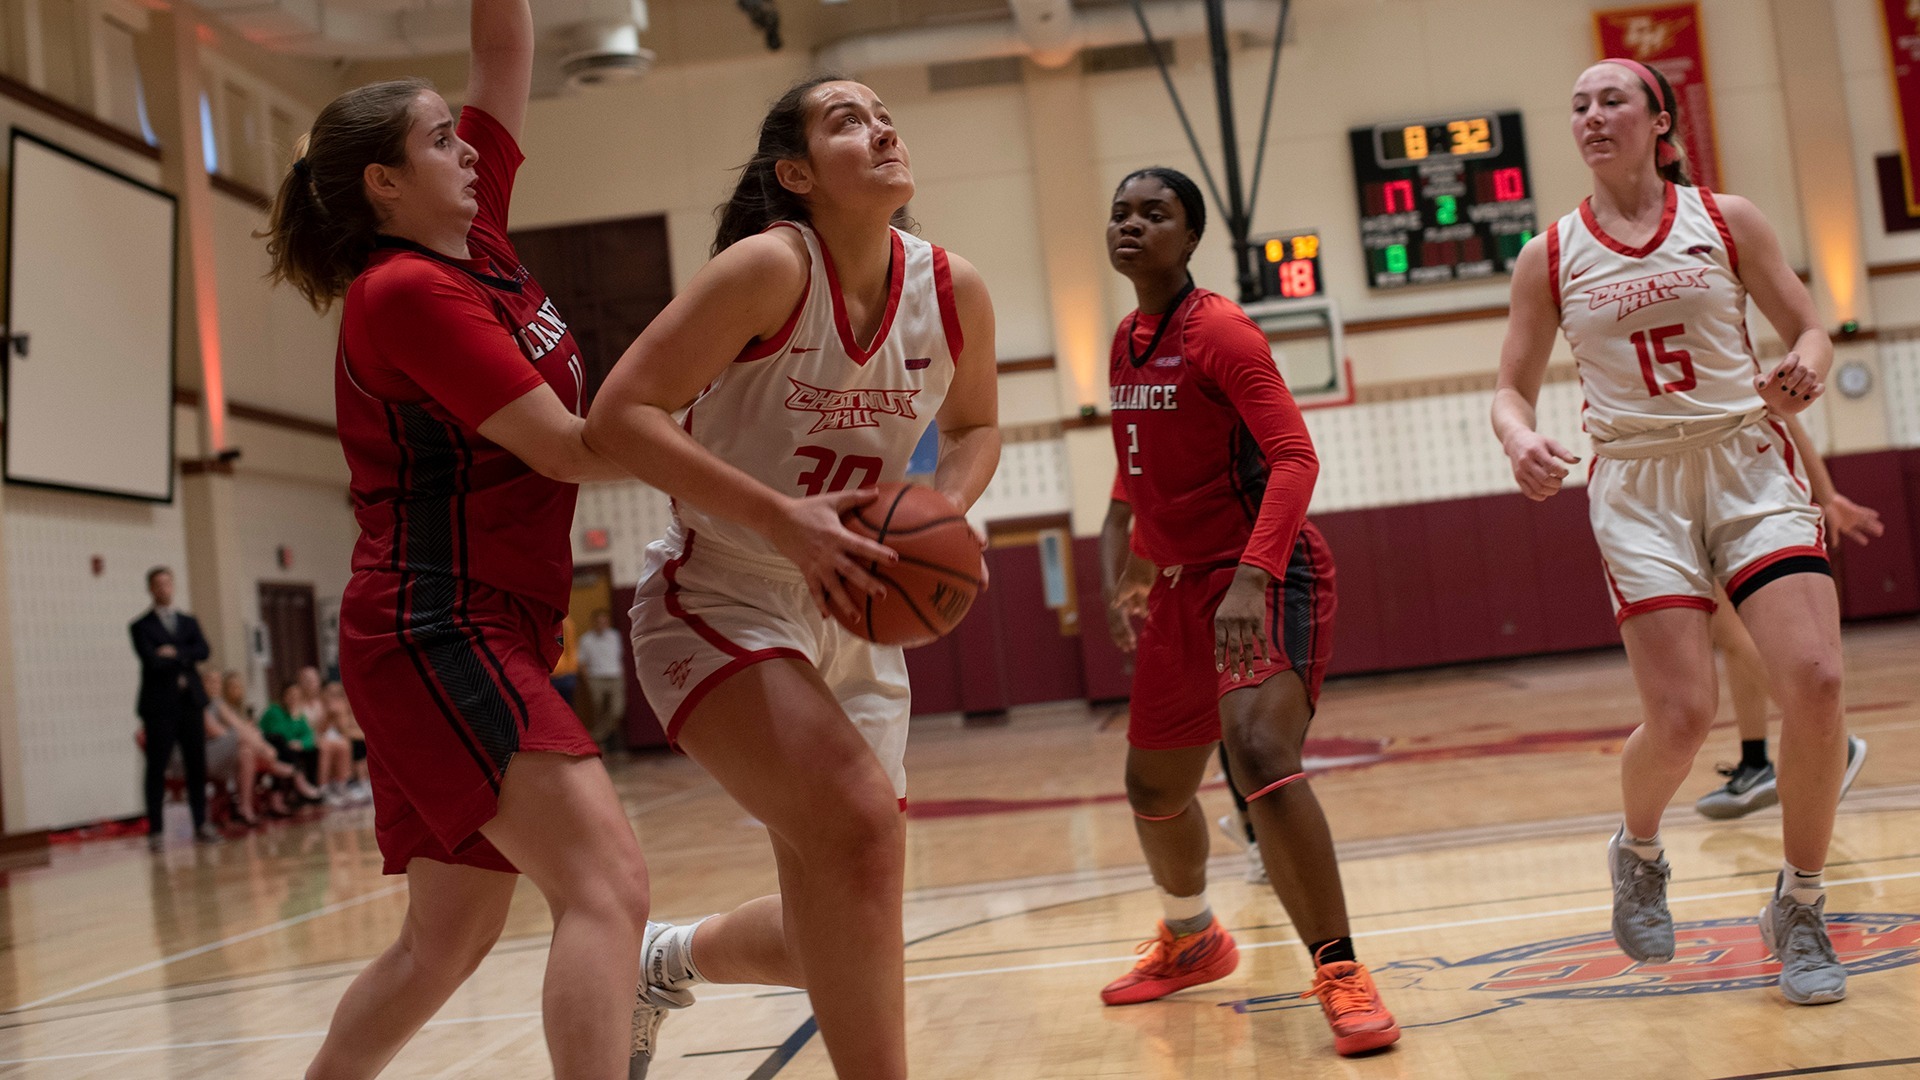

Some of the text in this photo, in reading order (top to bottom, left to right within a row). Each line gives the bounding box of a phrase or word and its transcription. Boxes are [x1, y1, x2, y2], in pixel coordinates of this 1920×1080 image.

[1630, 323, 1697, 397] 15
[785, 376, 921, 420] CHESTNUT
[1110, 384, 1178, 411] LLIANCE
[807, 407, 880, 435] HILL
[1126, 423, 1143, 475] 2
